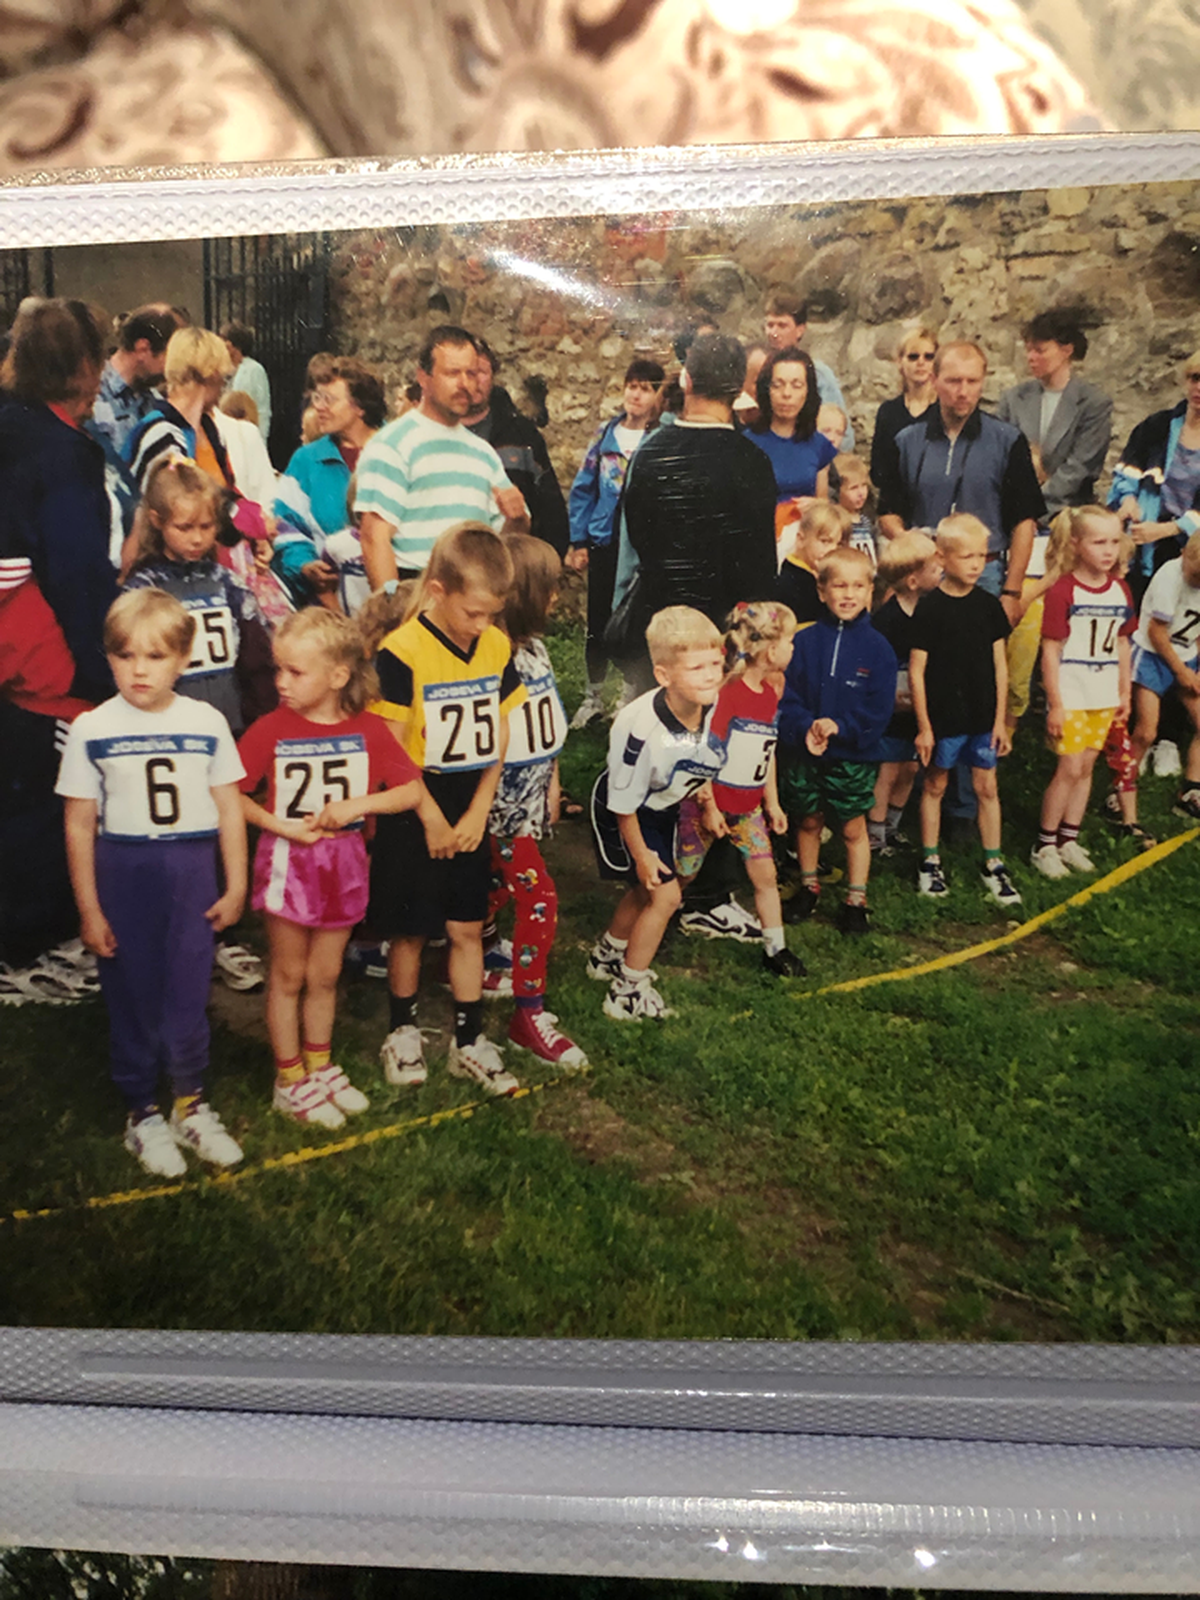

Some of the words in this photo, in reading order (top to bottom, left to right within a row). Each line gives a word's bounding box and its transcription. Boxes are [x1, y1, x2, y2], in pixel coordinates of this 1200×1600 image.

[440, 698, 495, 764] 25
[522, 695, 556, 754] 10
[284, 758, 351, 819] 25
[752, 739, 777, 782] 3
[145, 757, 181, 826] 6
